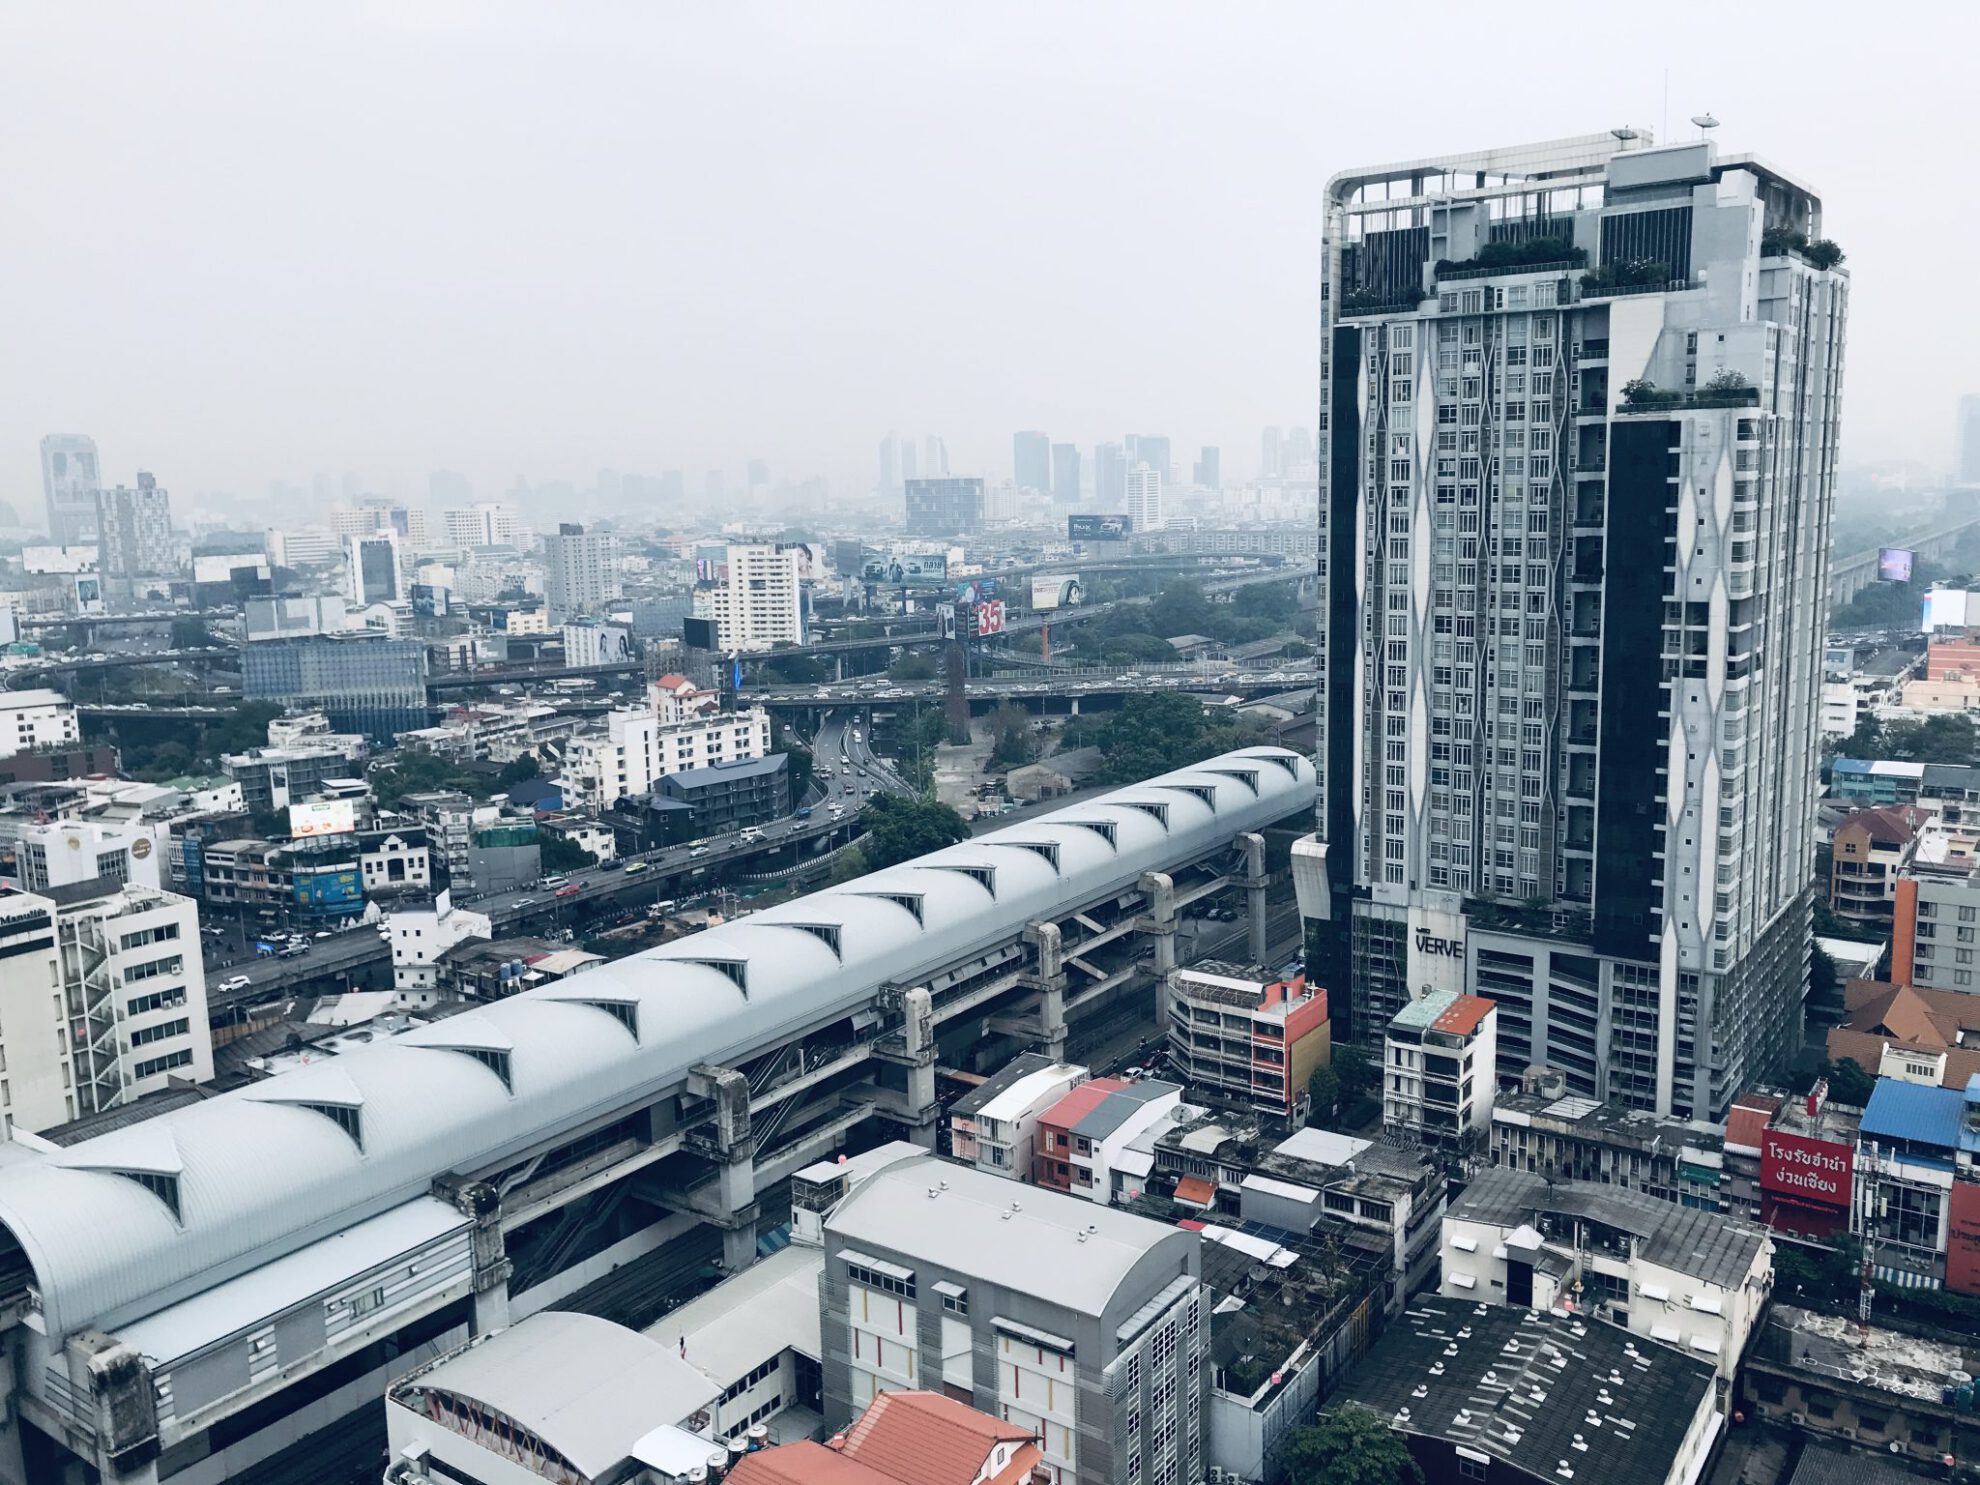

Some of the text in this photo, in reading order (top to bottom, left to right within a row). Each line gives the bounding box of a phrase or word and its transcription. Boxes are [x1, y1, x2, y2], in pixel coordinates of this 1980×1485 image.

[1416, 935, 1463, 959] VERVE
[1769, 1142, 1847, 1172] โรงรับจำนำ
